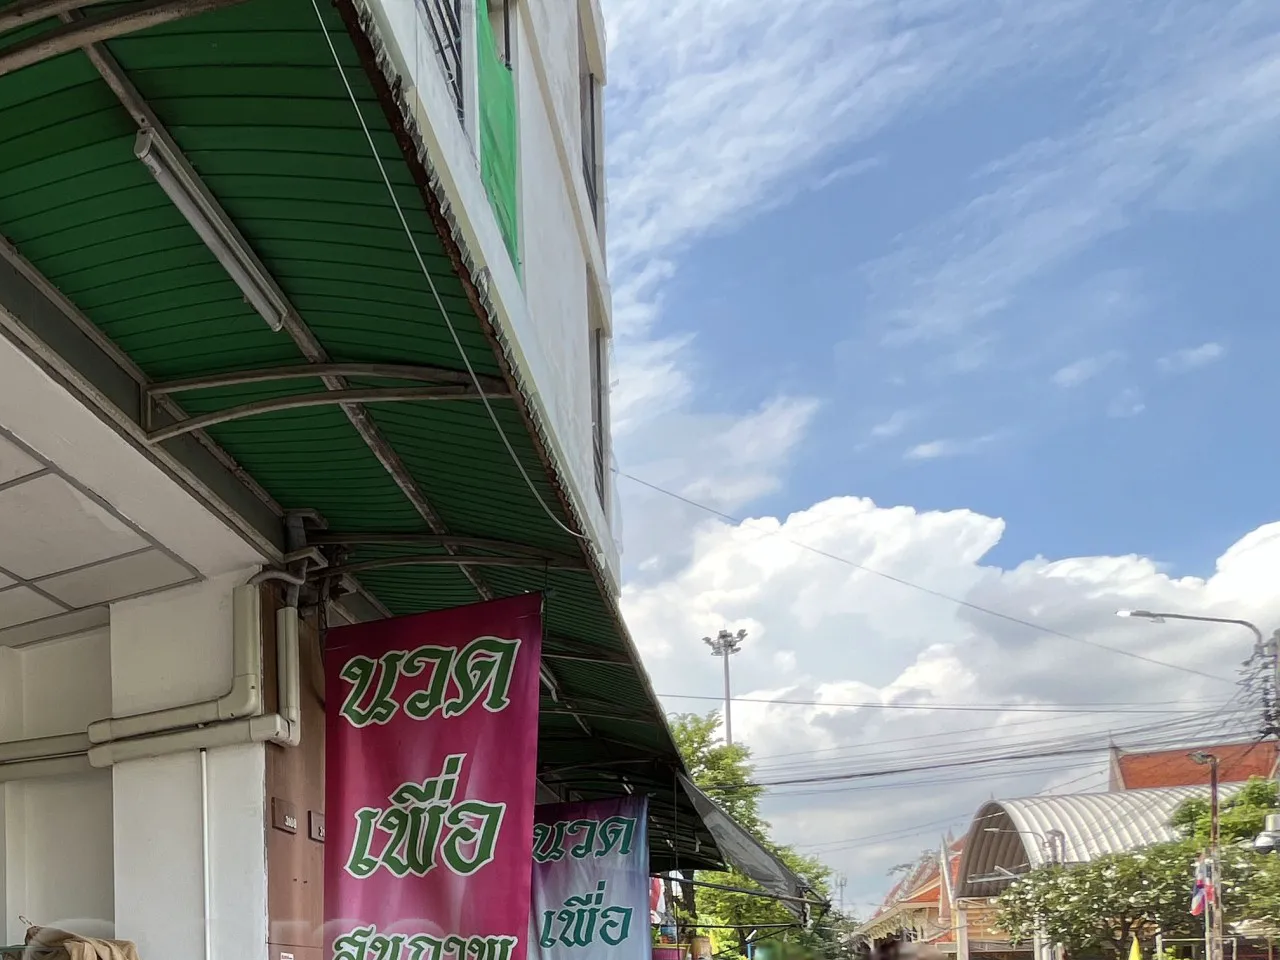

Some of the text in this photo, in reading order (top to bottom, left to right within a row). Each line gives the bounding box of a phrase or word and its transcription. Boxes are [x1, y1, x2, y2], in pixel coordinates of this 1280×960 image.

[339, 636, 521, 728] นวด
[345, 753, 507, 878] เพื่อ
[532, 817, 634, 862] นวด
[539, 881, 633, 948] เพื่อ
